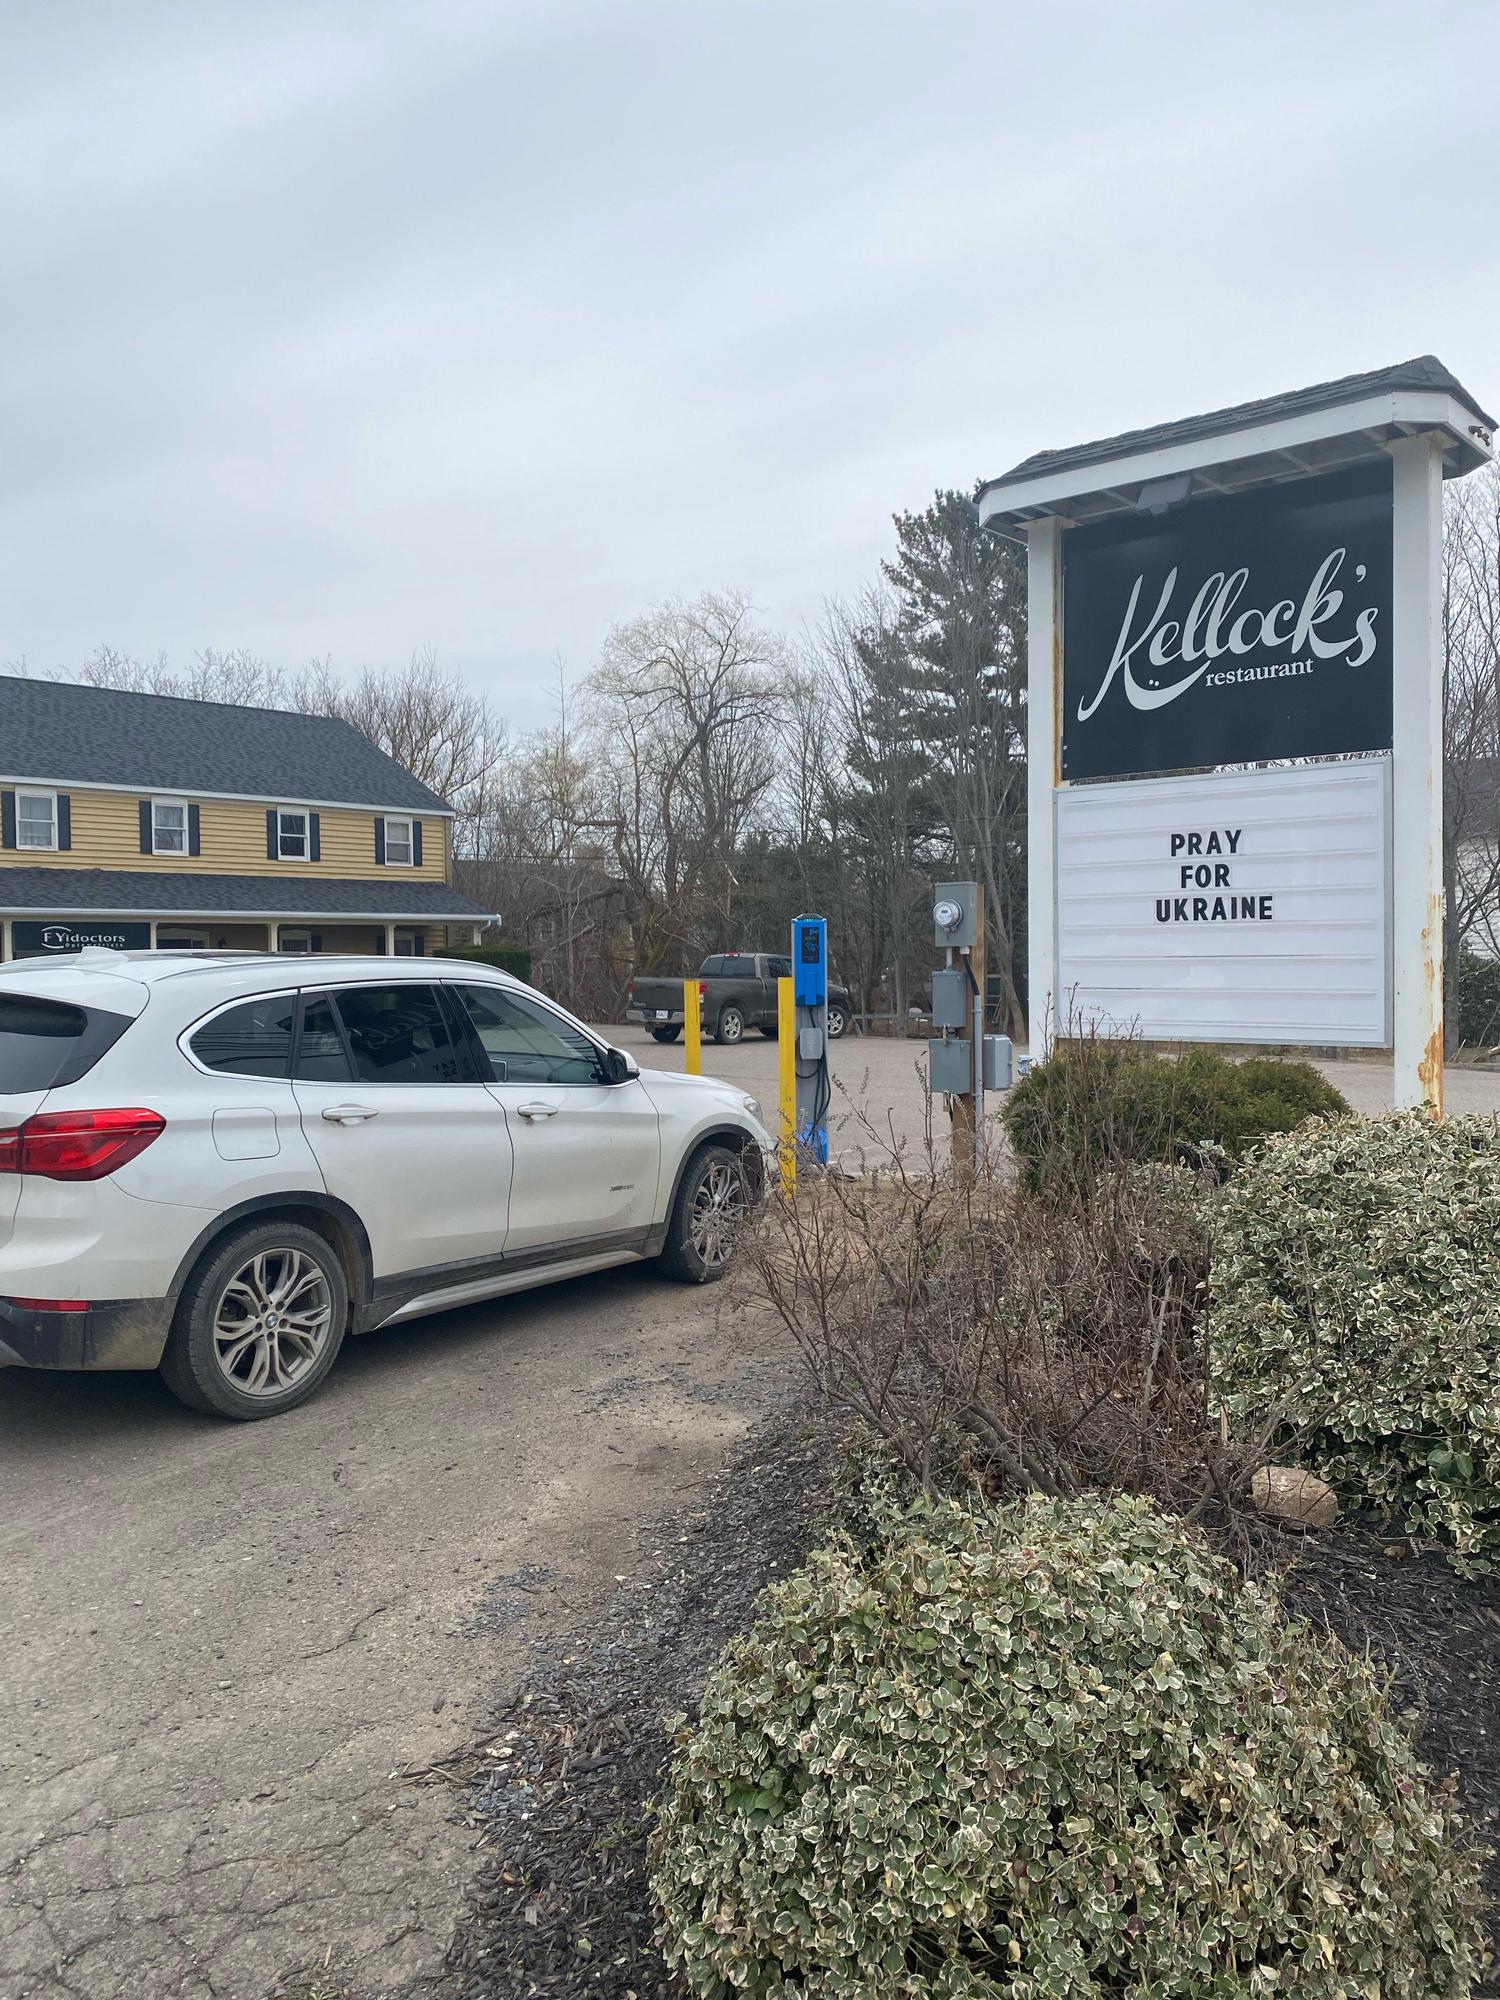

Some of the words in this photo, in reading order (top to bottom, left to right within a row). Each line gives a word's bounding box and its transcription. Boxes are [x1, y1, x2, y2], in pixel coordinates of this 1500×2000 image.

[1077, 547, 1379, 722] Kellock's
[1205, 657, 1315, 687] restaurant
[1170, 829, 1242, 857] PRAY
[1180, 863, 1231, 889] FOR
[1156, 895, 1273, 923] UKRAINE
